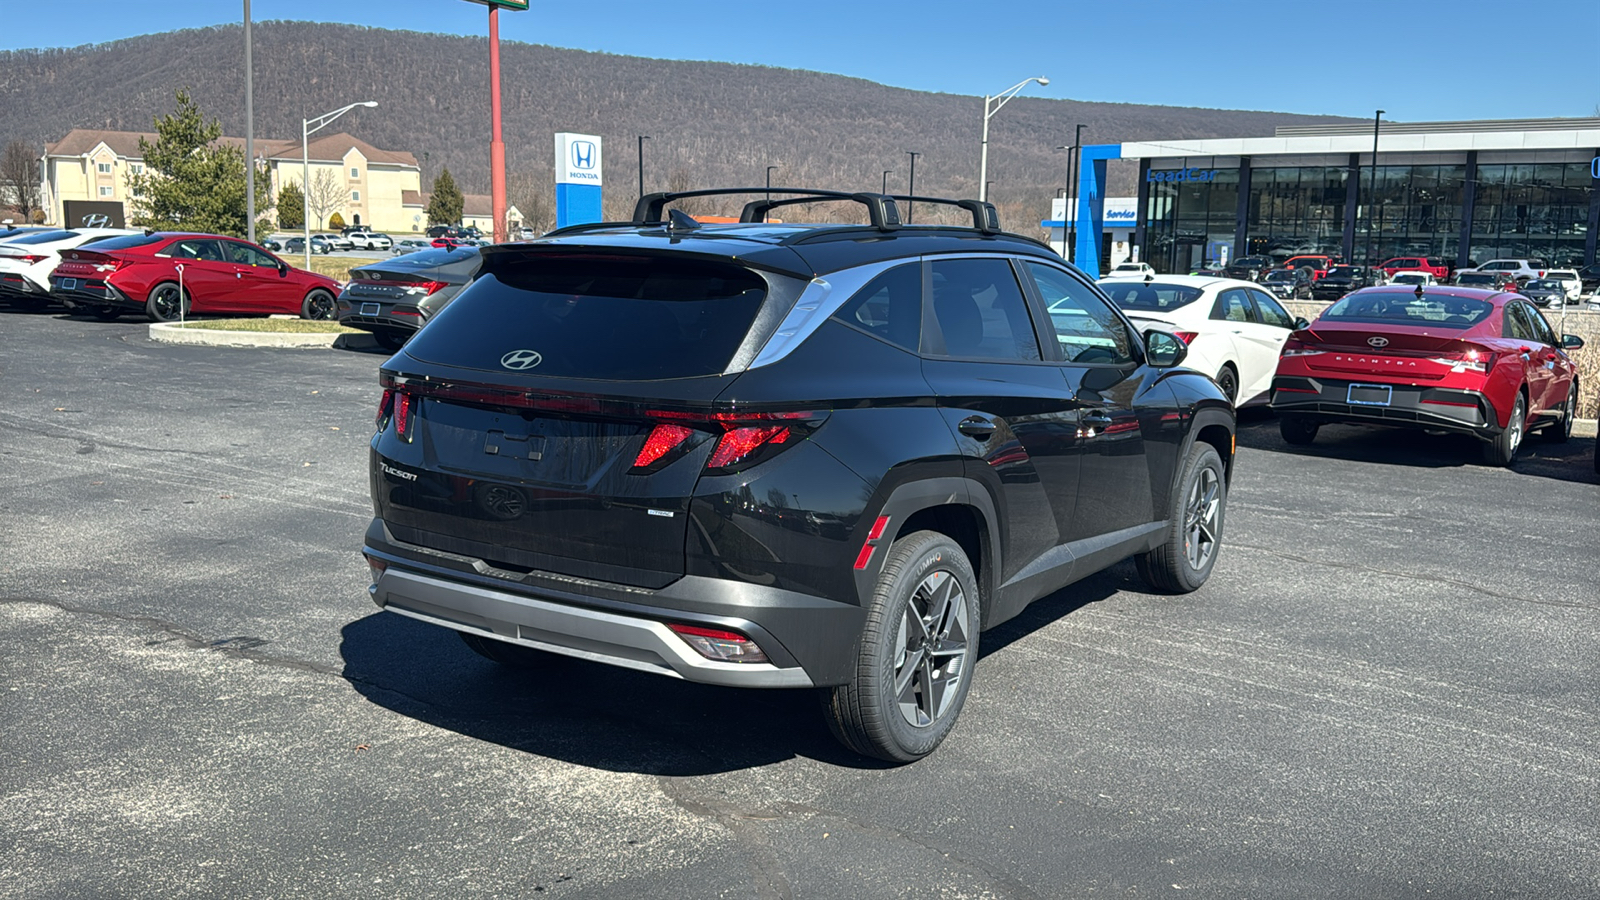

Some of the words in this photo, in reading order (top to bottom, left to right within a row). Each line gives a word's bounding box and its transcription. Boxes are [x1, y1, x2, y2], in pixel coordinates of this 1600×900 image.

[570, 172, 599, 180] HONDA
[1147, 167, 1217, 182] LeadCar
[1106, 209, 1136, 219] Service
[1335, 356, 1416, 366] ELANTRA
